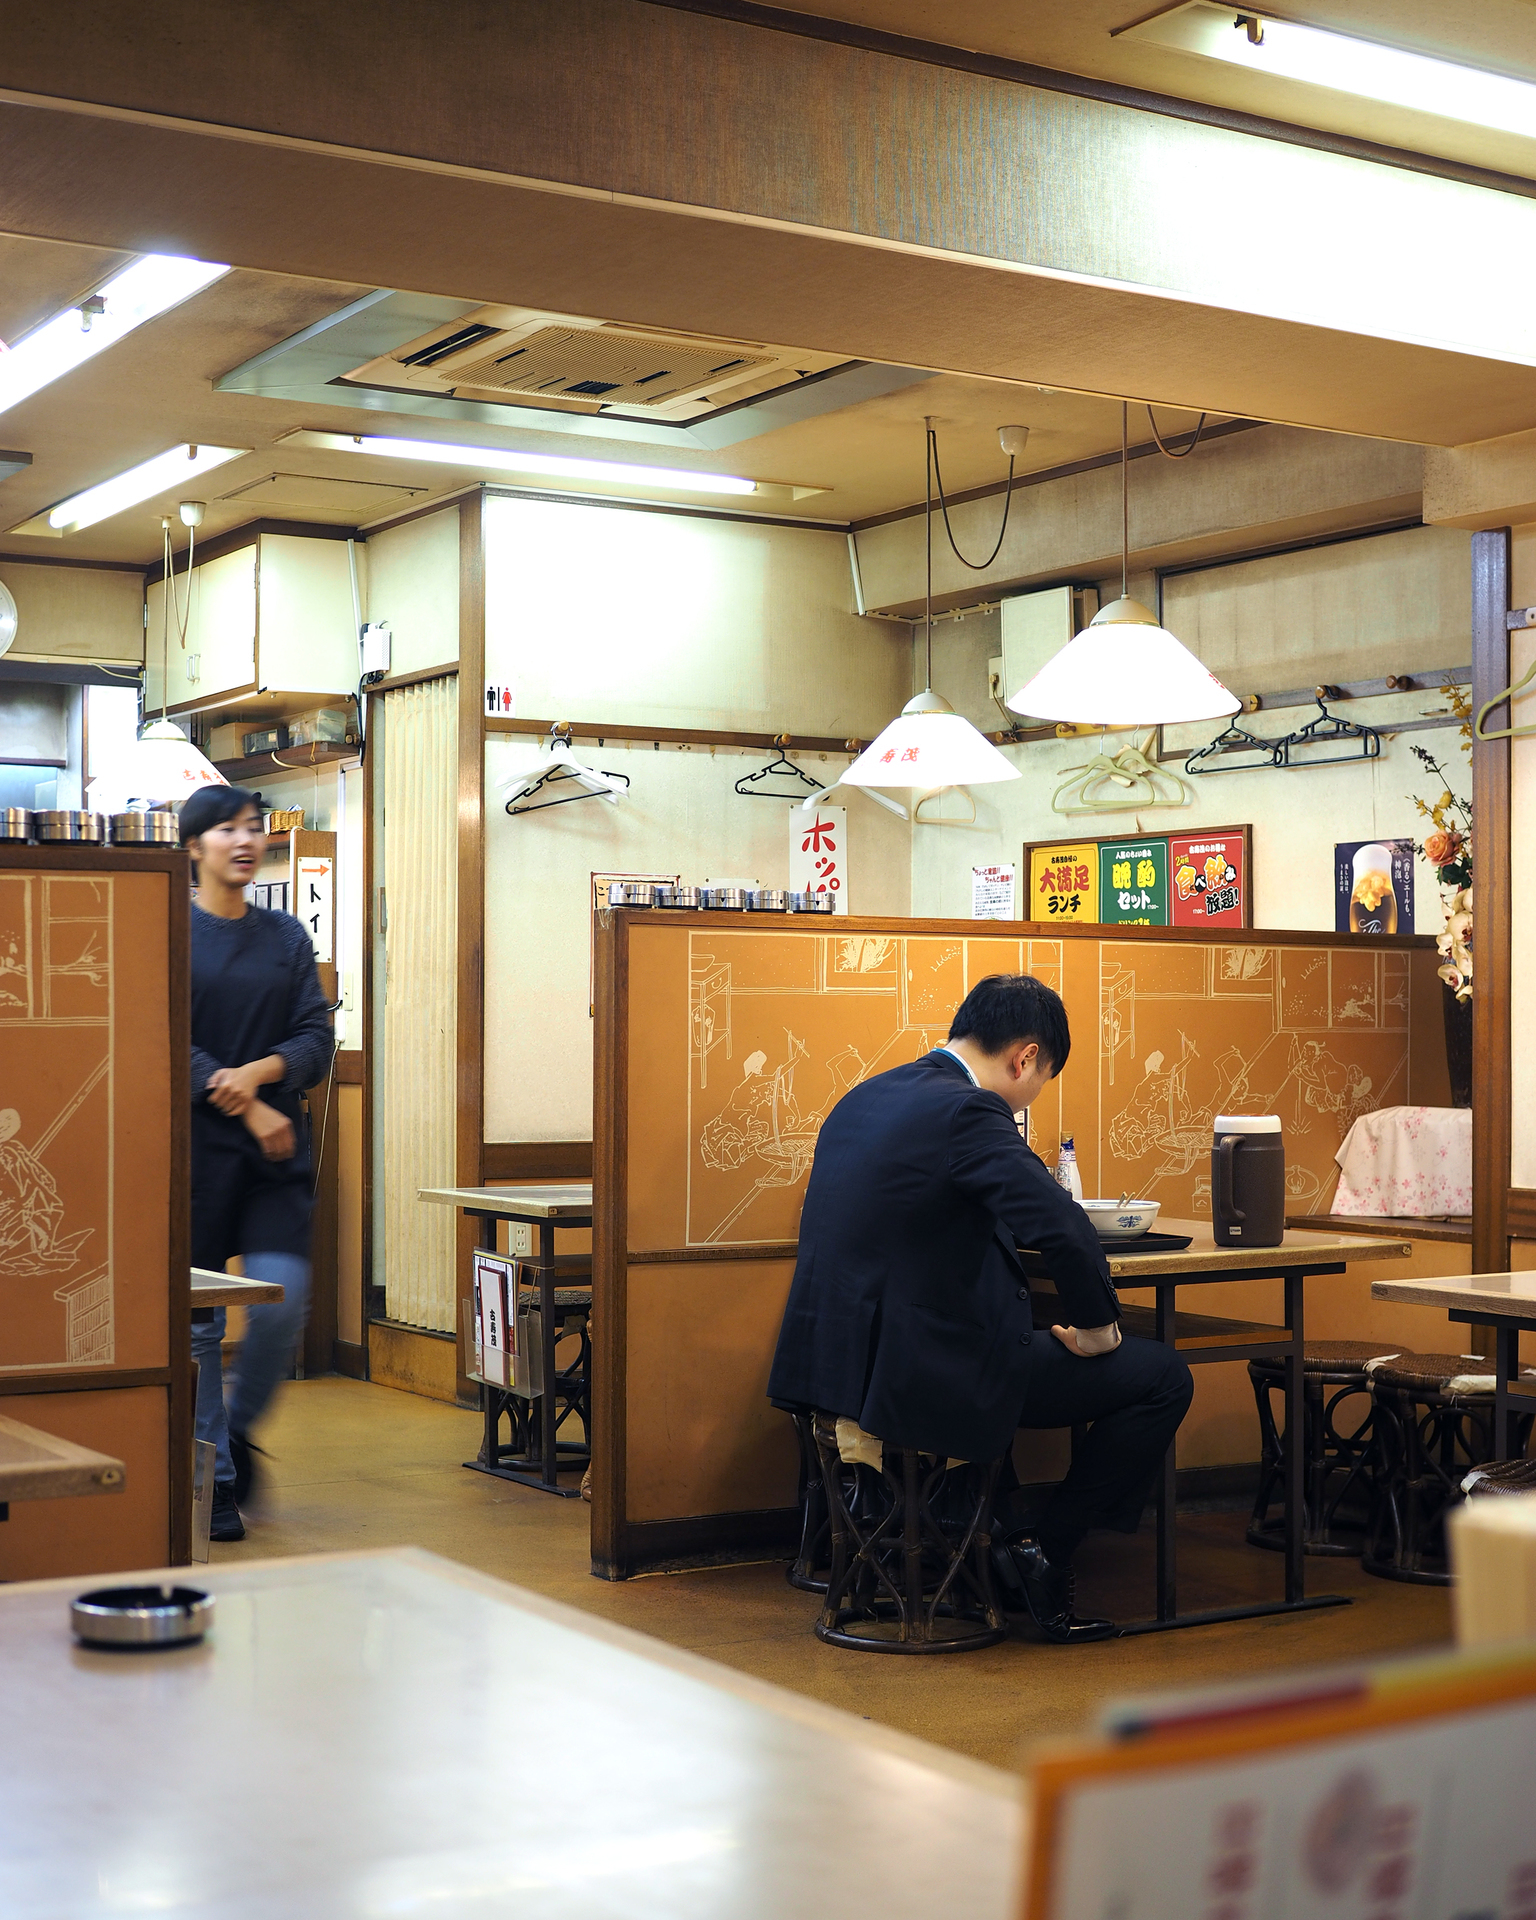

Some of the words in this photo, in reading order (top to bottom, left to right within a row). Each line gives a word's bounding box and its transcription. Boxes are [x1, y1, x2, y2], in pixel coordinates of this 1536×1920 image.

[1039, 864, 1090, 893] 大満足
[1112, 859, 1156, 889] 晩酌
[1048, 894, 1081, 914] ランチ
[1117, 889, 1151, 910] セット
[1205, 886, 1240, 916] 放題!
